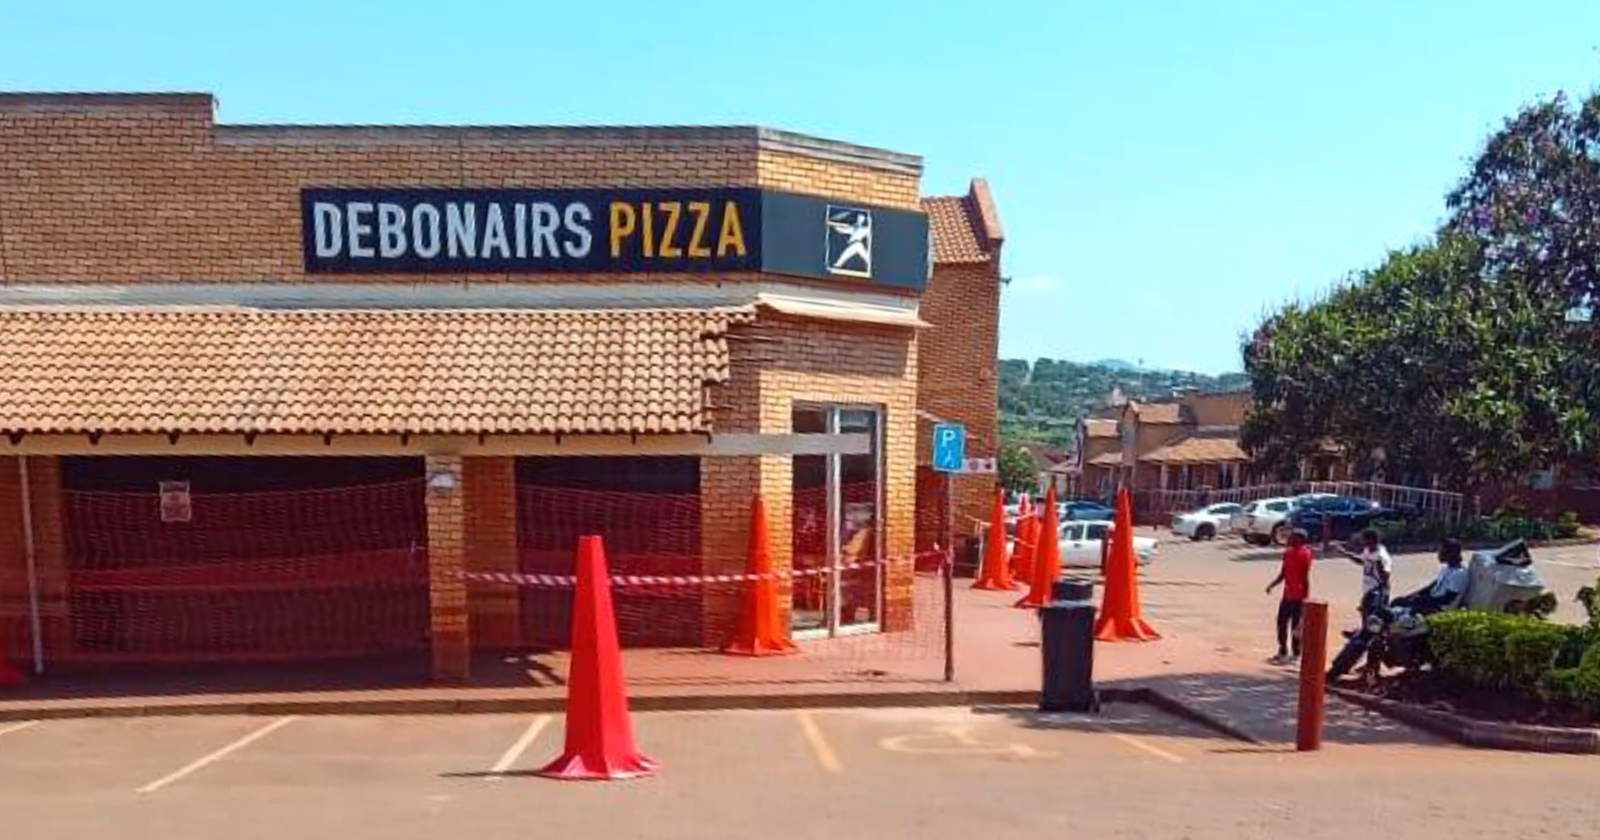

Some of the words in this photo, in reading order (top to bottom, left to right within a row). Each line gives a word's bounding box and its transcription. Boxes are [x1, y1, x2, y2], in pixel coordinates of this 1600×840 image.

[313, 201, 593, 258] DEBONAIRS
[609, 201, 747, 257] PIZZA
[942, 430, 956, 447] P
